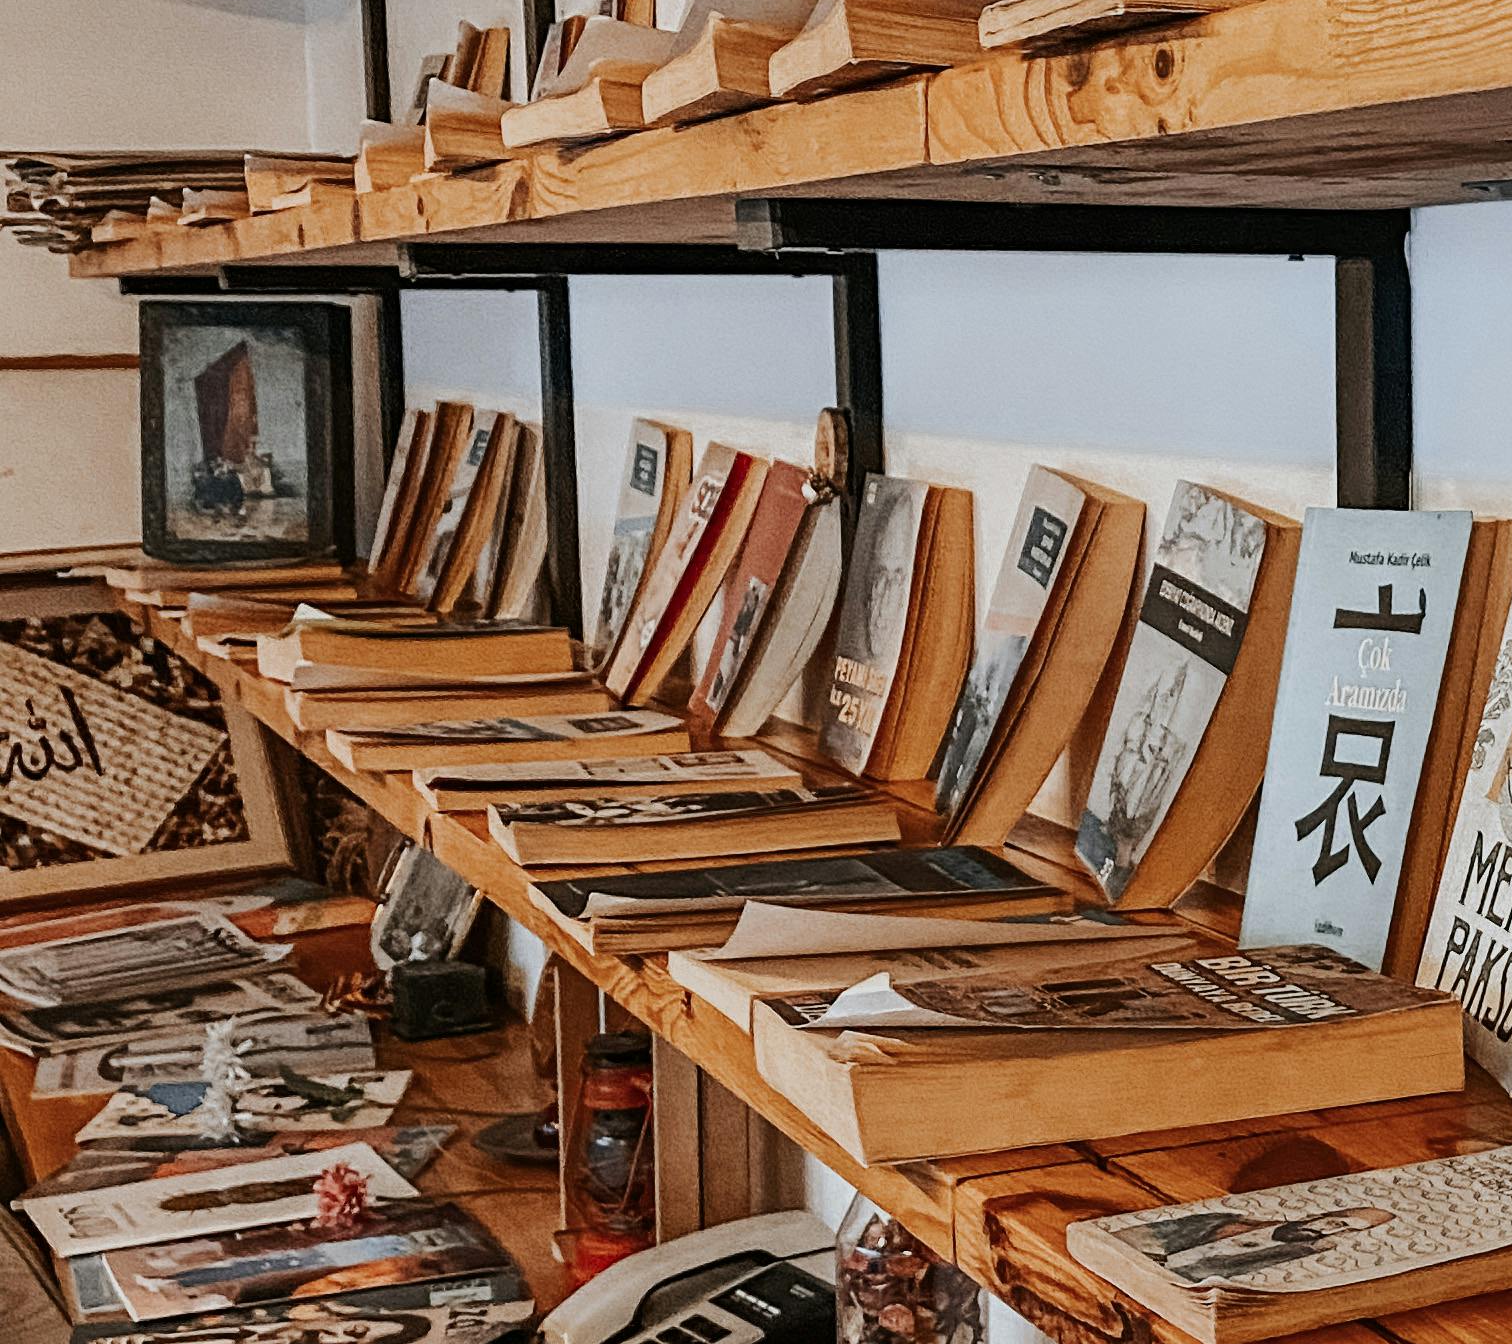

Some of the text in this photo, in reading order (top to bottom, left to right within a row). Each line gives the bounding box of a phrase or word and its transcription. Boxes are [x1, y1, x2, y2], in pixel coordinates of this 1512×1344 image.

[1348, 551, 1385, 567] Mustafa
[1358, 637, 1391, 678] Çok
[1325, 675, 1408, 713] Aramızda
[1195, 955, 1281, 986] BİR
